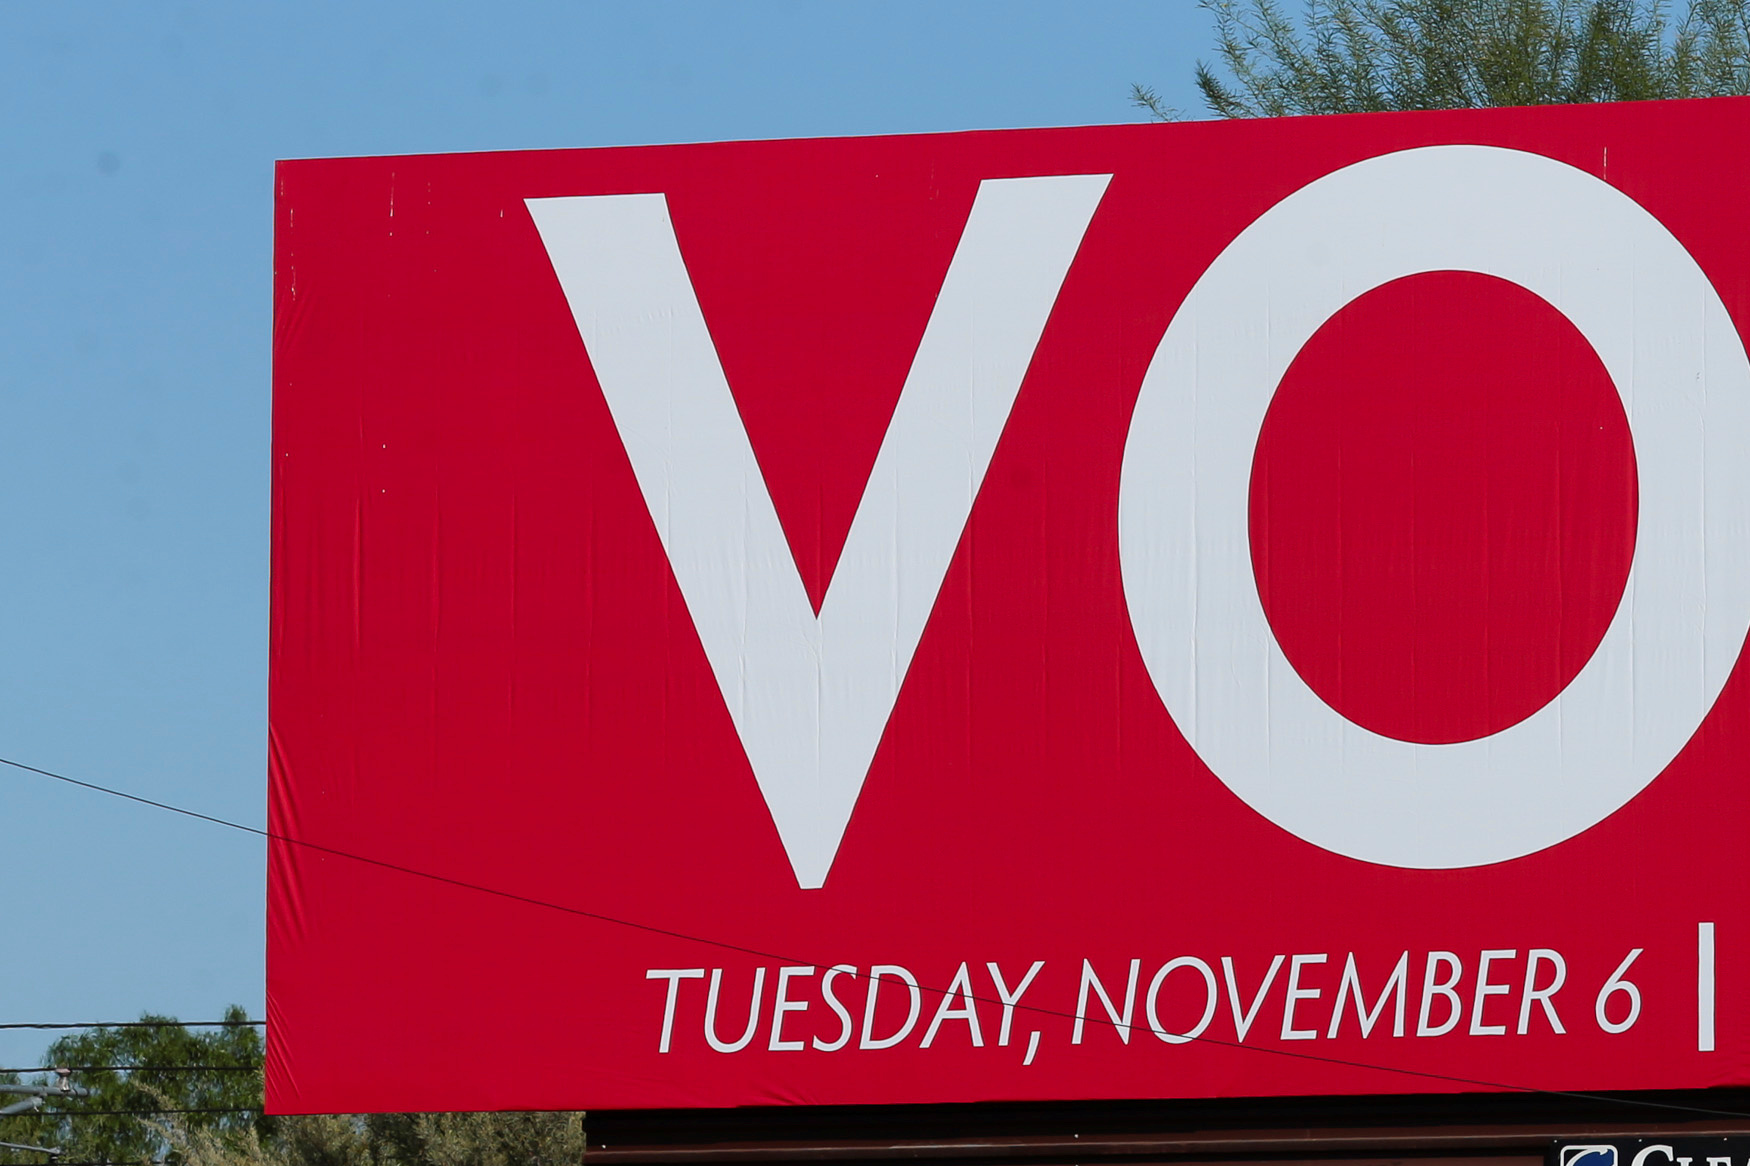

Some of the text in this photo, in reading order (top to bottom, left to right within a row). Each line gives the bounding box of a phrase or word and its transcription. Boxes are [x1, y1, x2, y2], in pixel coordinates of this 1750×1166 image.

[644, 947, 1644, 1067] TUESDAY, NOVEMBER 6
